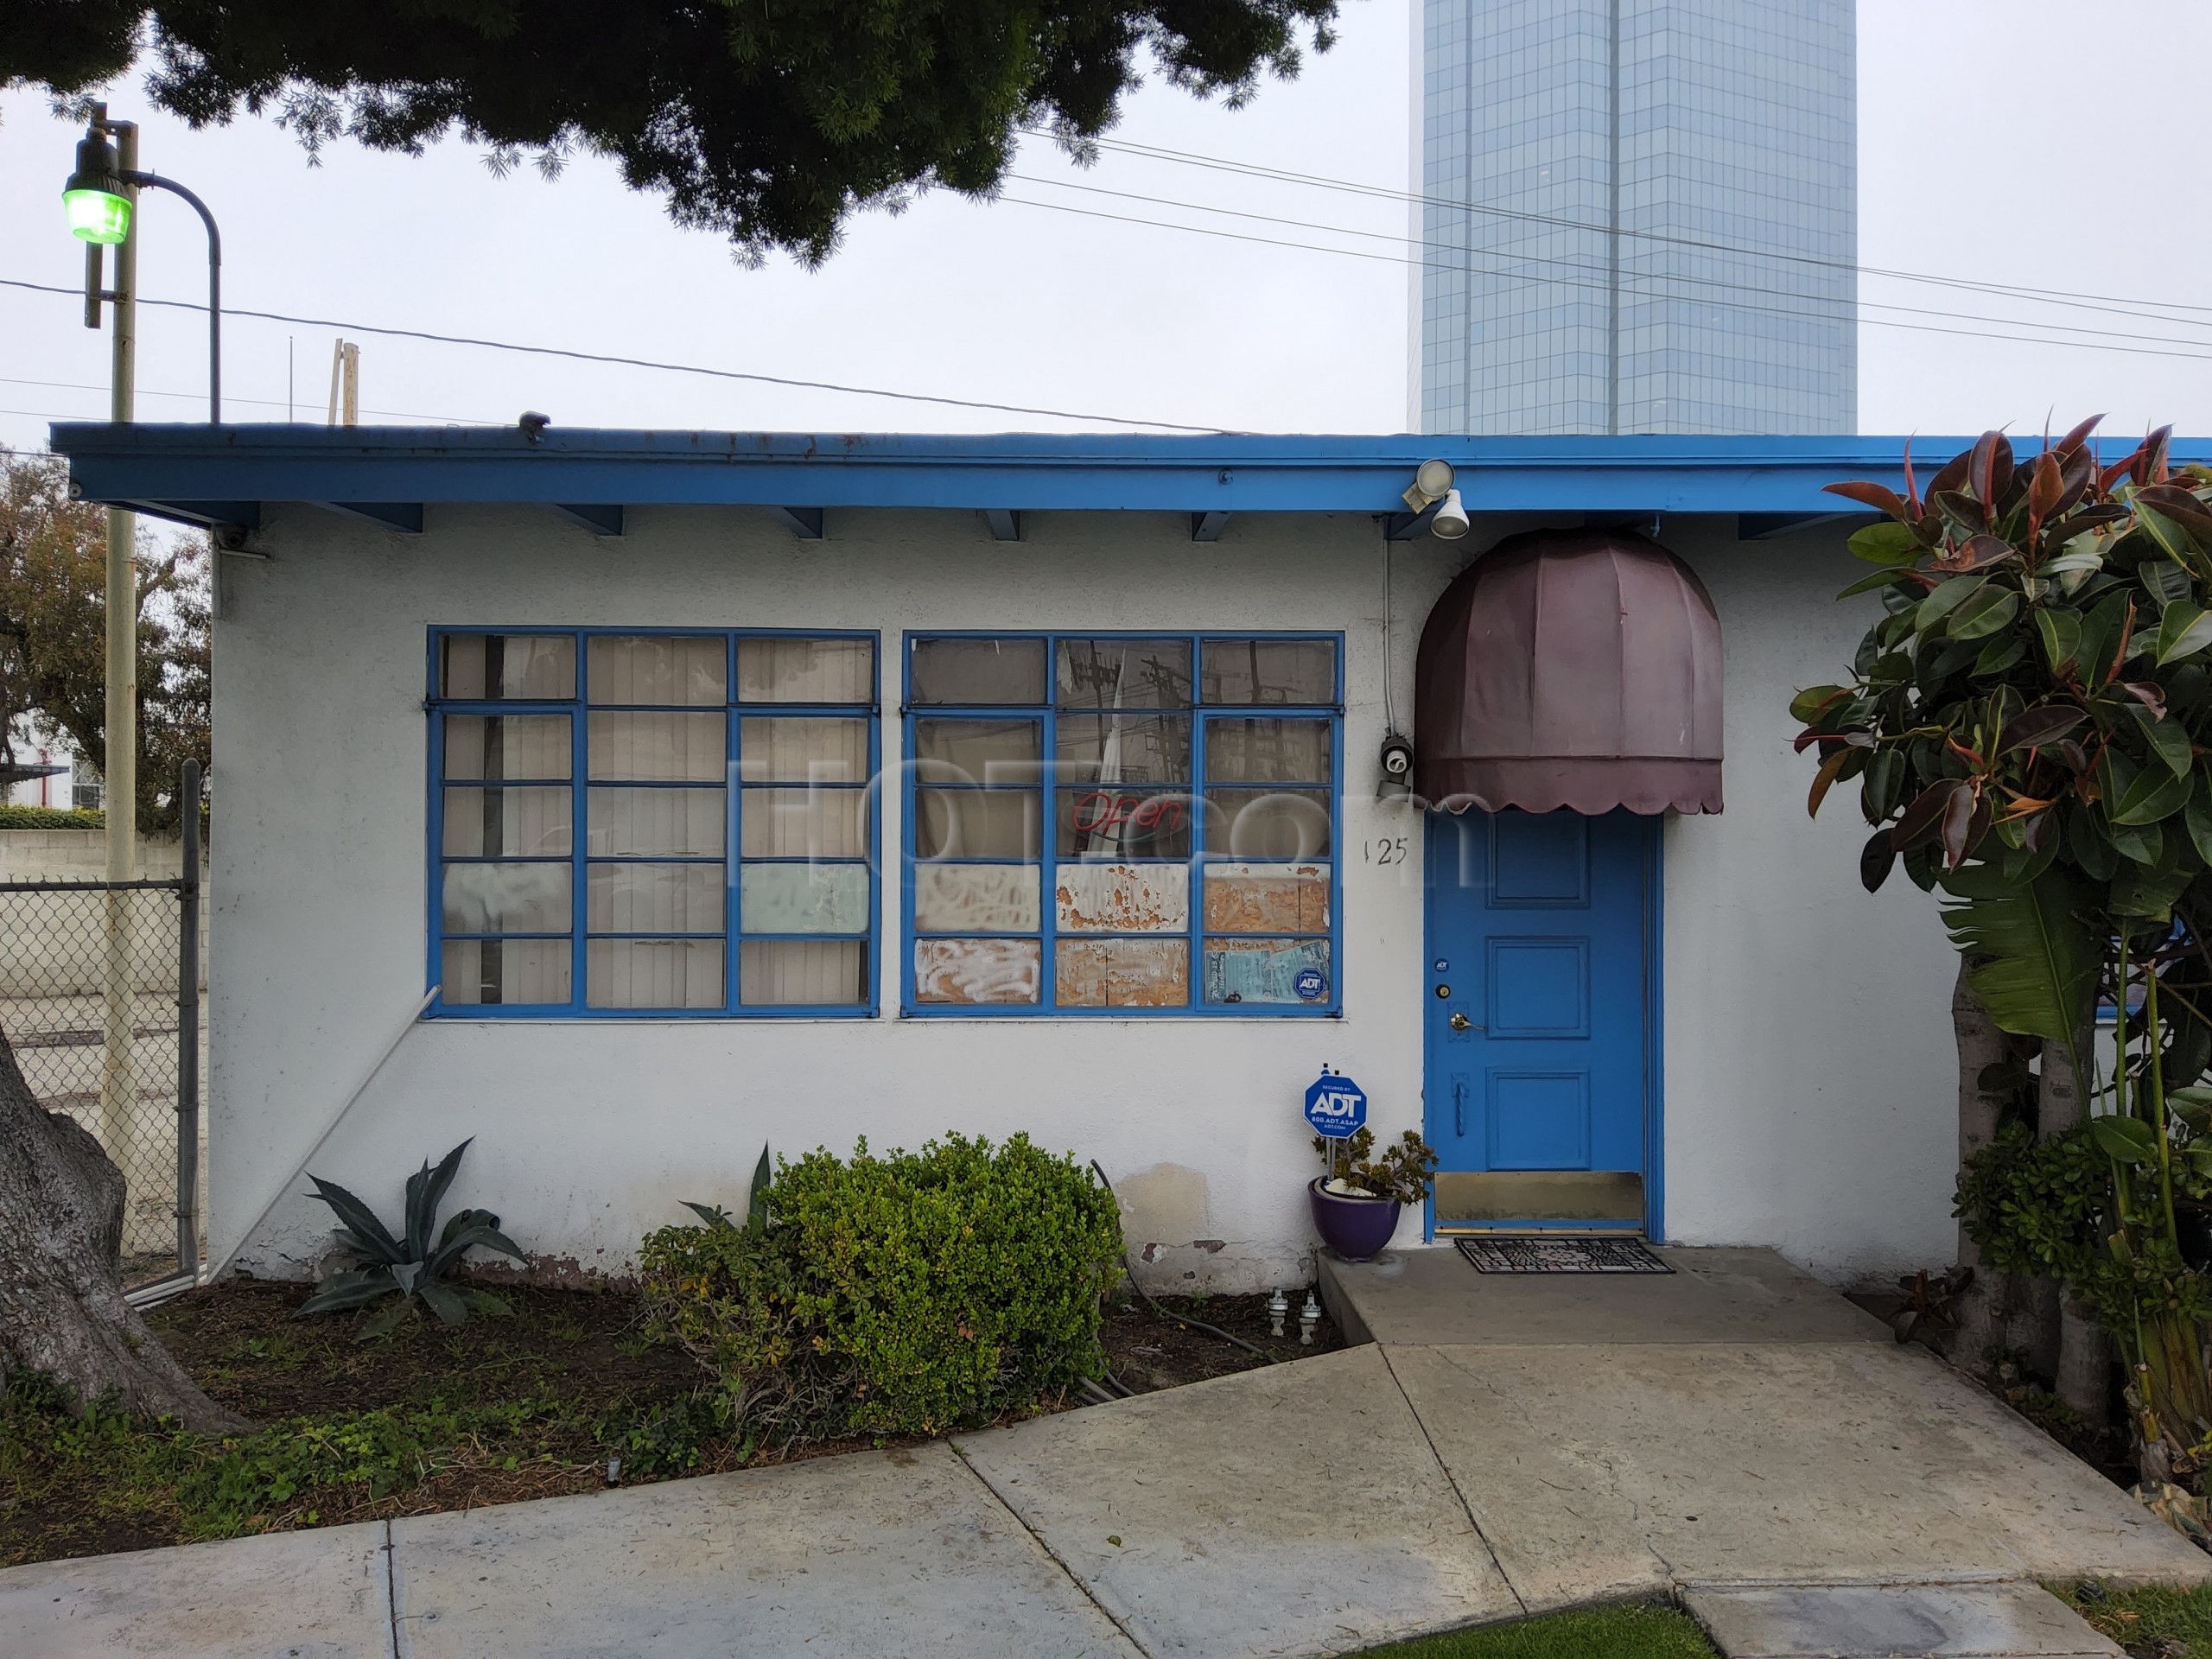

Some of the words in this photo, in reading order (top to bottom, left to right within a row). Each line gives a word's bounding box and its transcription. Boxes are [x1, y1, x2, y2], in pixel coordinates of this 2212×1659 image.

[1364, 837, 1408, 866] 125
[1299, 978, 1320, 988] ADT
[1310, 1091, 1362, 1118] ADT
